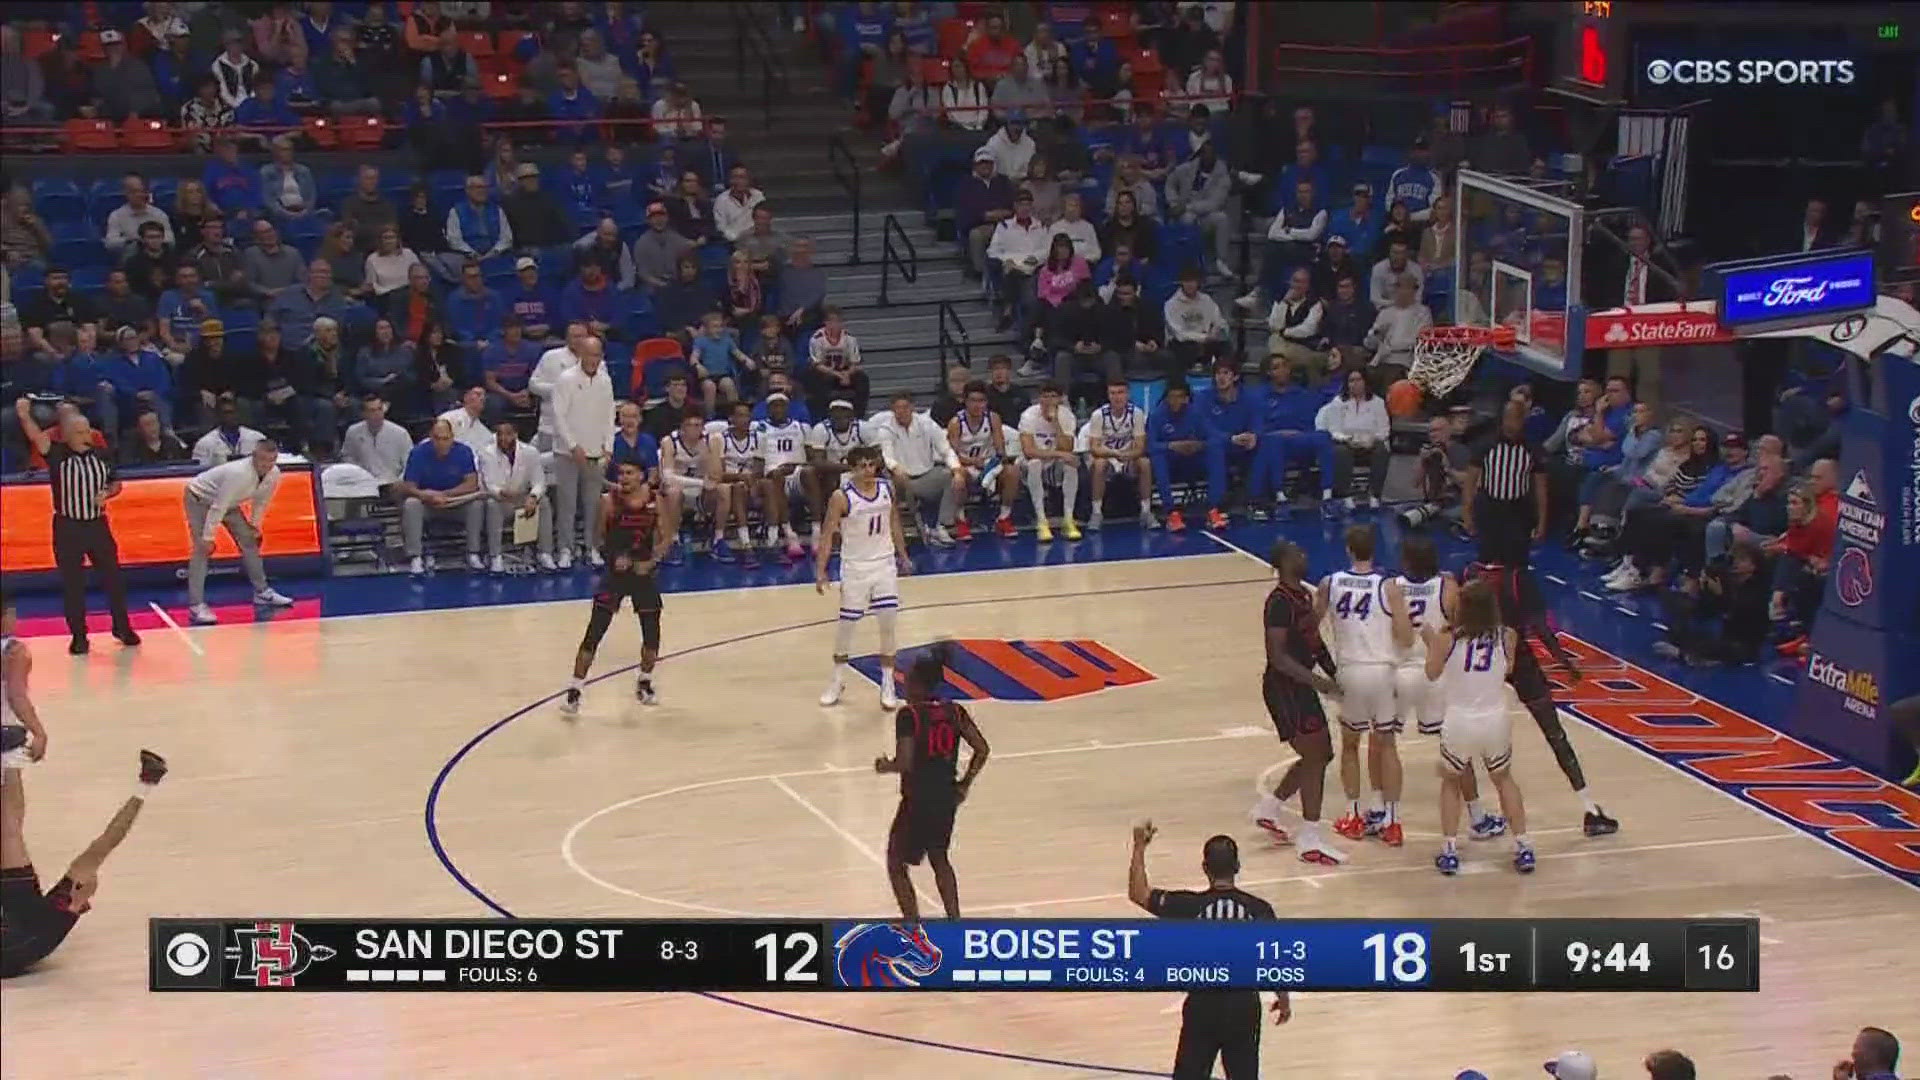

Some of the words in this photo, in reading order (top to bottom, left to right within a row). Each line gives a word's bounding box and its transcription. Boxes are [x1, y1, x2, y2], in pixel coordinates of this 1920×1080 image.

[1763, 276, 1828, 307] Ford
[777, 439, 793, 451] 10
[867, 515, 883, 537] 11
[1336, 591, 1373, 620] 44
[1408, 599, 1427, 627] 2
[1464, 641, 1493, 672] 13
[927, 722, 955, 757] 10
